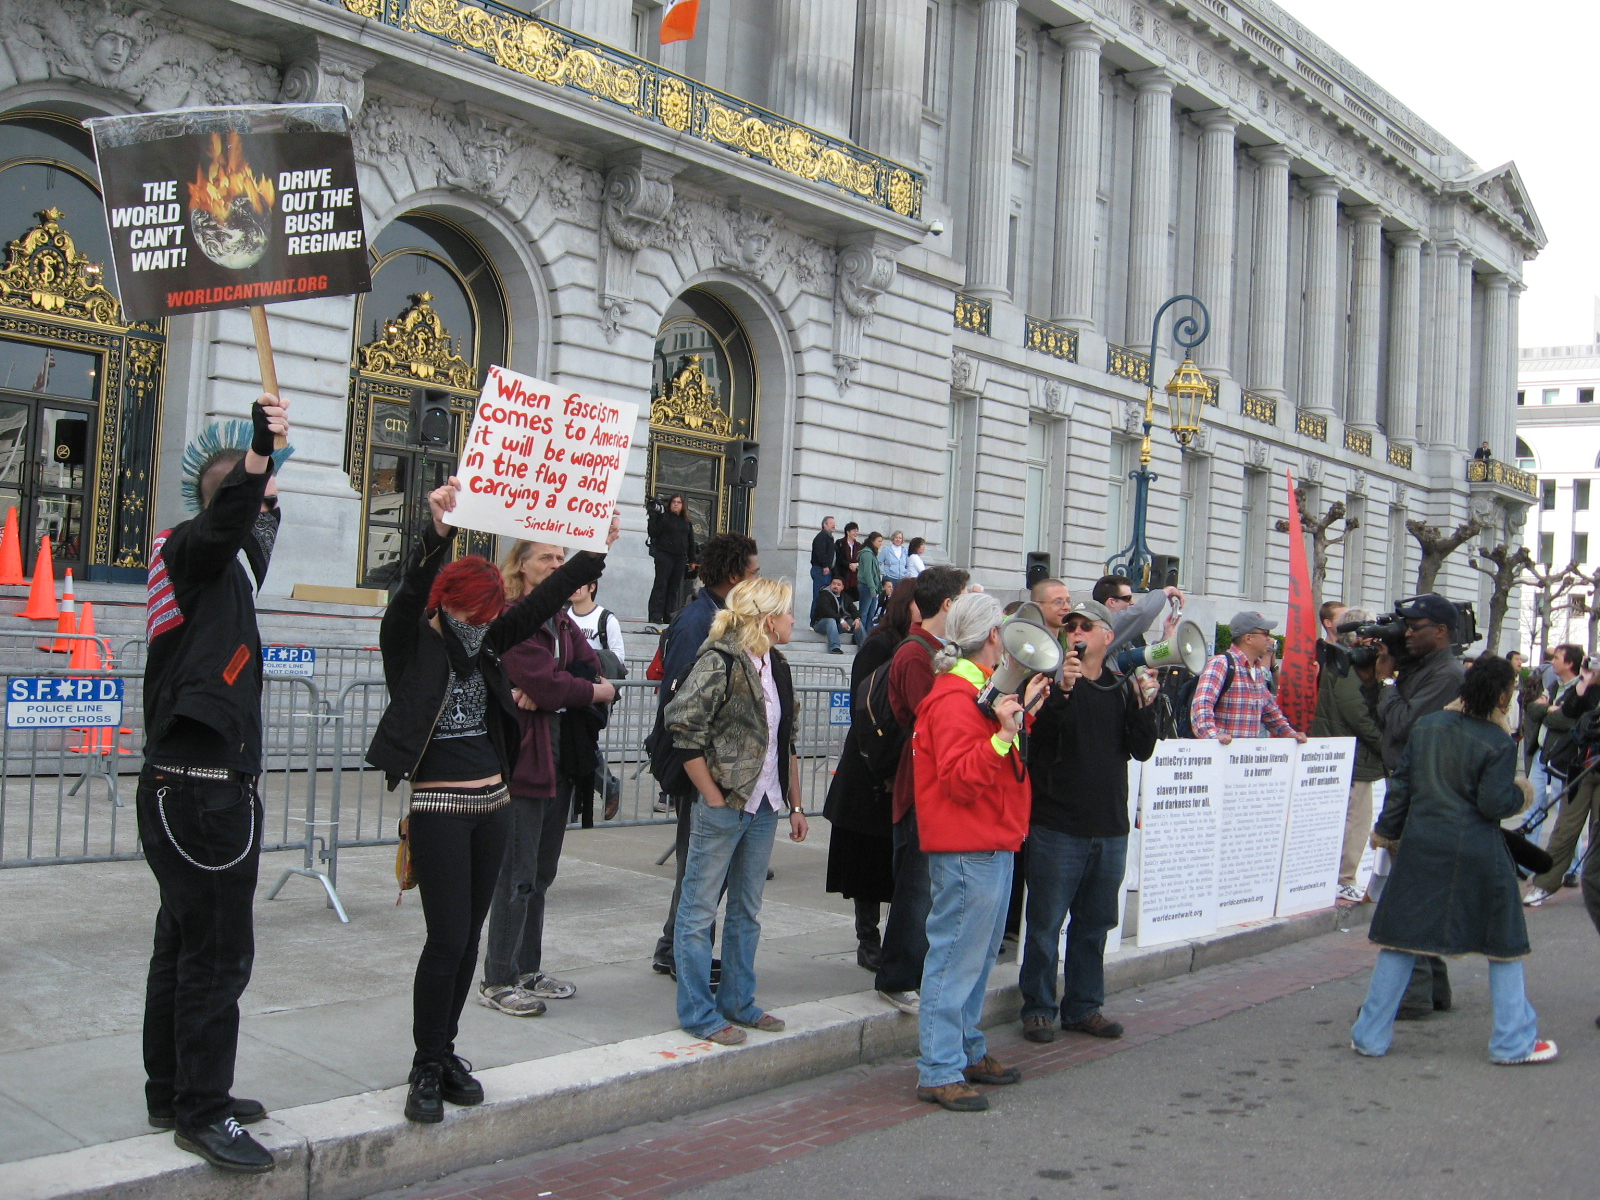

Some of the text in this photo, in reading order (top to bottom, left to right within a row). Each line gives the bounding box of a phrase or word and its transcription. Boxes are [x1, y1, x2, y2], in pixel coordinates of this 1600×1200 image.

[278, 168, 332, 191] DRIVE
[143, 181, 178, 202] THE
[282, 188, 354, 212] OUT THE
[112, 203, 180, 228] WORLD
[285, 212, 334, 234] BUSH
[130, 226, 184, 249] CAN'T
[288, 230, 362, 255] REGIME!
[132, 248, 187, 272] WAIT!
[167, 275, 328, 307] WORLDCANTWAIT.ORG
[563, 393, 619, 424] fascism
[385, 418, 409, 432] CITY
[479, 403, 629, 448] comes to America
[474, 425, 620, 476] it will be wrapped
[466, 448, 609, 495] in the flag and
[470, 475, 540, 510] carrying
[545, 494, 558, 509] a
[566, 521, 595, 538] Lewis
[1287, 604, 1302, 654] brand
[1155, 756, 1212, 766] BattleCry's program
[1230, 754, 1289, 764] The Bible taken literally
[1301, 753, 1324, 762] BattleCry's
[1334, 751, 1346, 760] about
[1174, 772, 1193, 780] means
[1244, 768, 1249, 777] is
[1255, 767, 1272, 776] horror!
[1307, 765, 1325, 774] violence
[1157, 785, 1208, 795] slavery for women
[1317, 776, 1340, 786] metaphors.
[1153, 798, 1210, 810] and darkness for all.
[1290, 882, 1326, 893] worldcantwait.org
[1220, 896, 1263, 907] worldcantwait.org
[1152, 910, 1202, 922] worldcantwait.org
